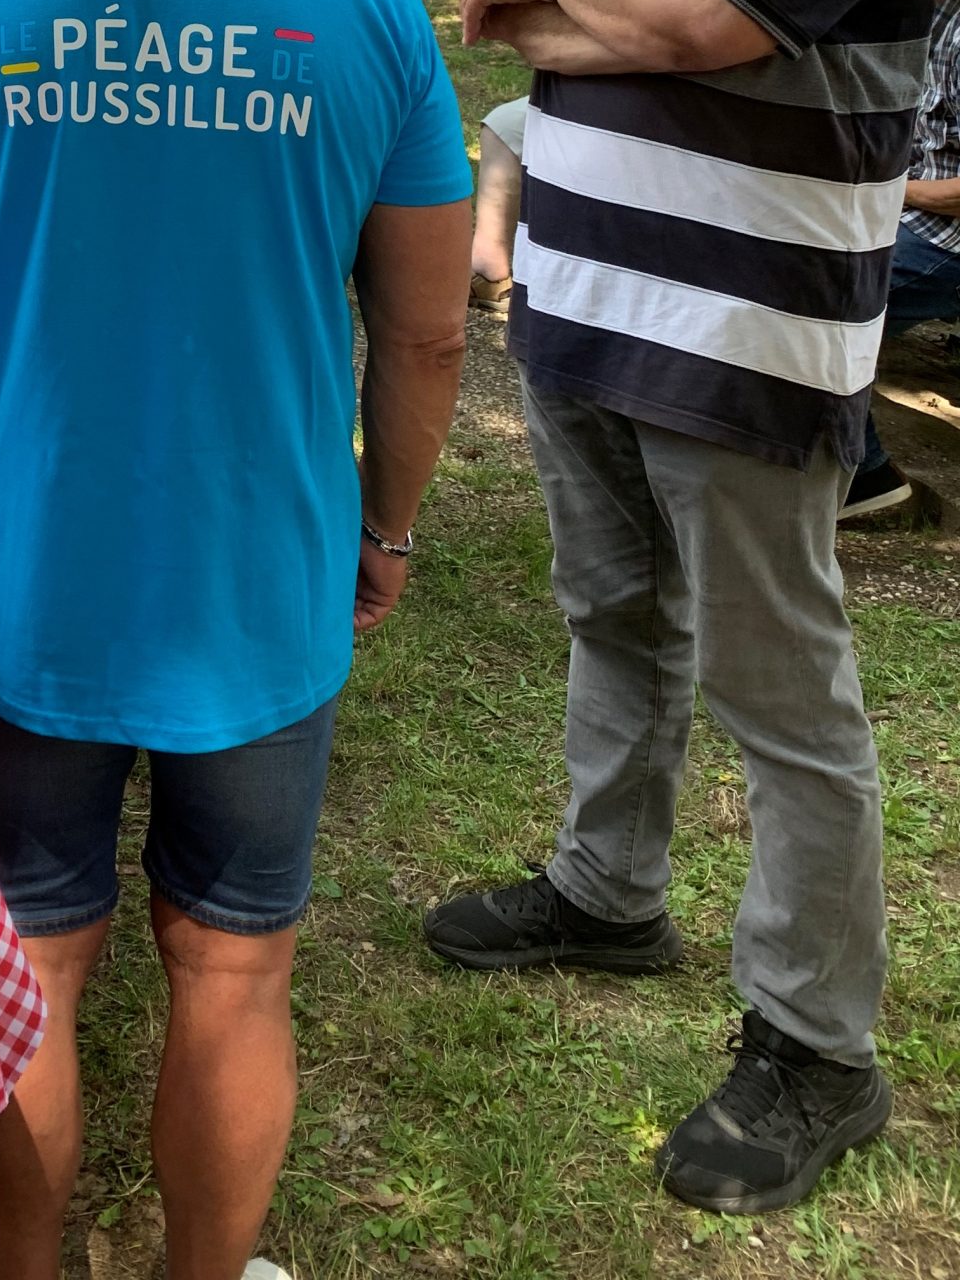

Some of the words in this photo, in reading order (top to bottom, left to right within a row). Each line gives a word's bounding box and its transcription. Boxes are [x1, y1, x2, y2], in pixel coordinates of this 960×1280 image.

[0, 21, 38, 55] LE
[52, 3, 259, 78] PÉAGE
[271, 48, 315, 85] DE
[3, 80, 313, 137] ROUSSILLON
